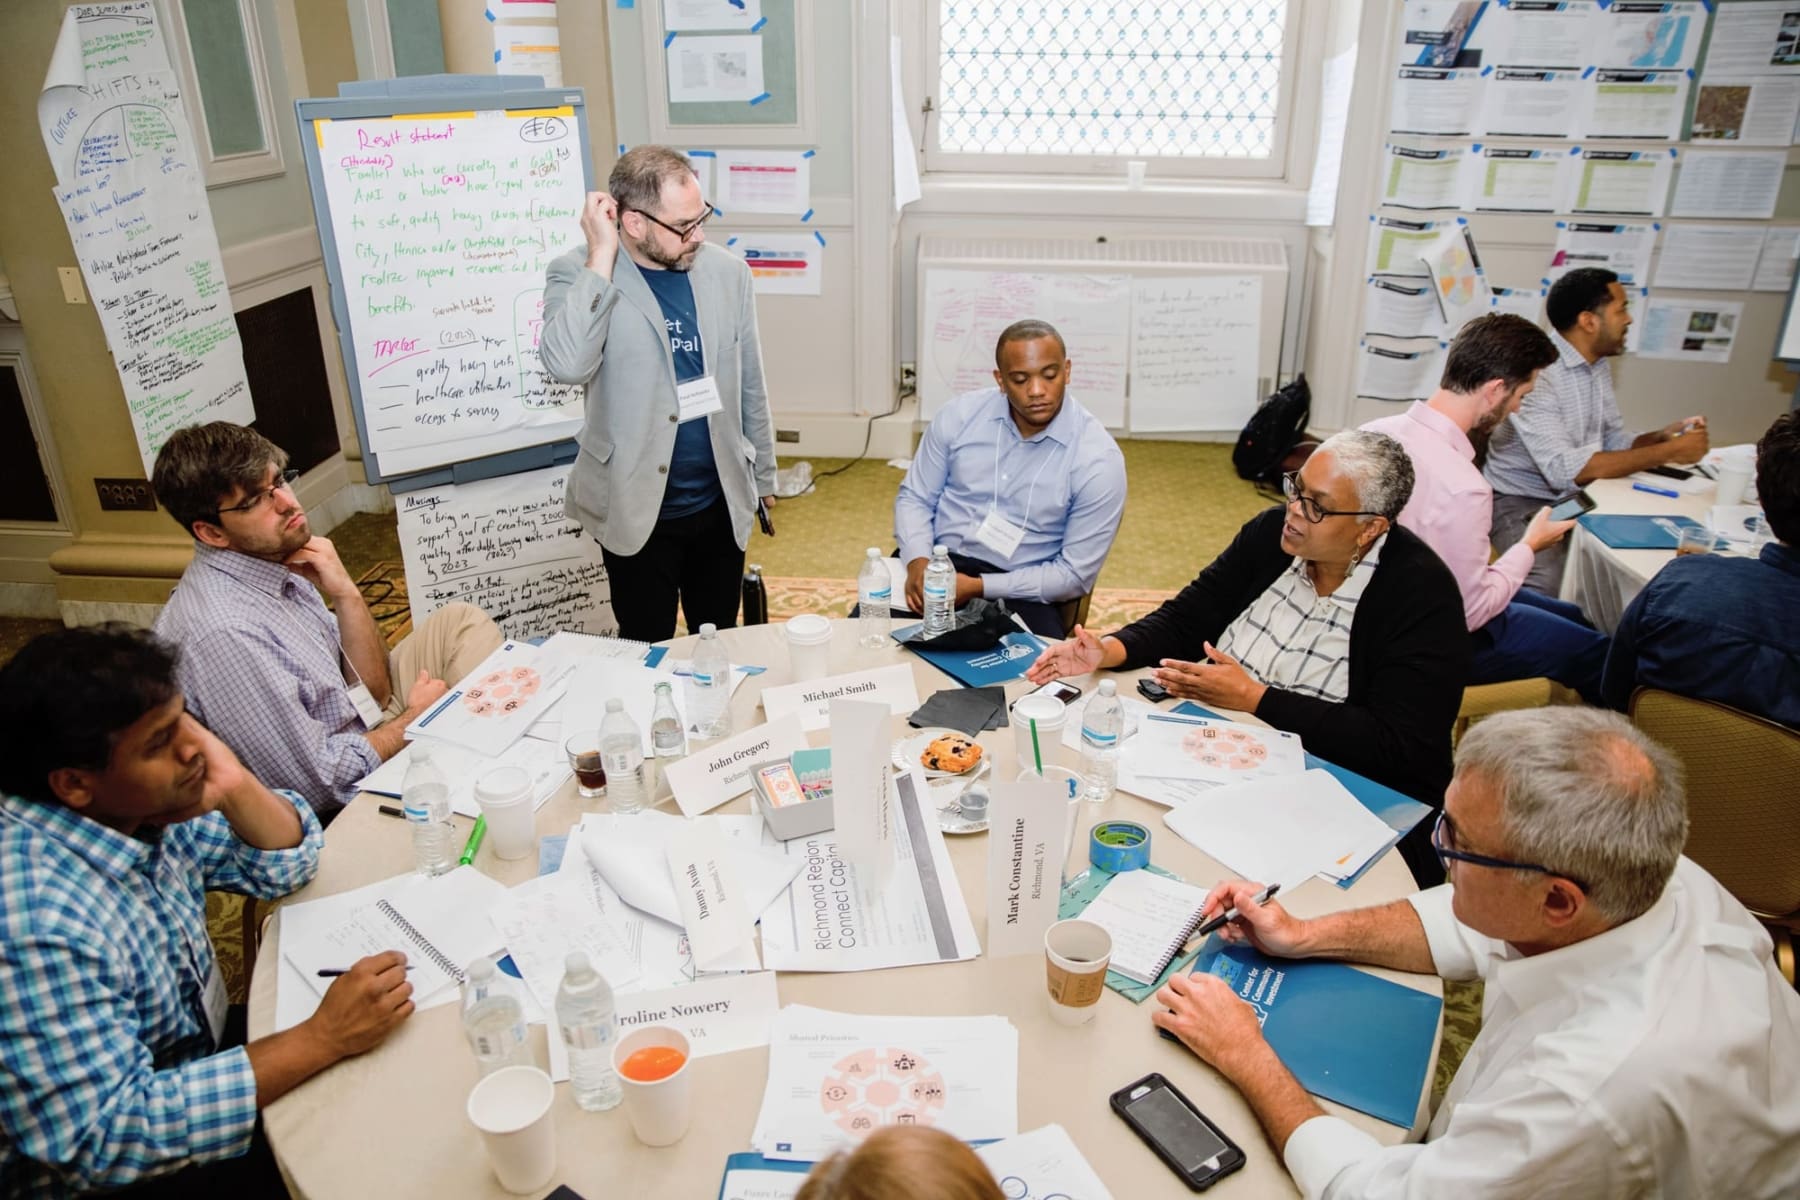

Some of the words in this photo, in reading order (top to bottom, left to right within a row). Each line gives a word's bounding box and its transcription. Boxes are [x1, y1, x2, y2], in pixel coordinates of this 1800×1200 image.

[77, 75, 142, 101] SHIFTS
[358, 128, 401, 150] Result
[405, 496, 440, 511] Musings
[420, 513, 432, 525] To
[435, 512, 457, 529] bring
[461, 512, 470, 520] in
[496, 505, 520, 517] major
[417, 527, 451, 548] support
[482, 519, 496, 535] of
[497, 515, 537, 533] creating
[420, 546, 451, 565] quality
[457, 538, 496, 556] affordable
[427, 564, 438, 582] by
[441, 560, 469, 575] 2023
[459, 582, 471, 592] To
[803, 688, 844, 703] Michael
[845, 681, 877, 696] Smith
[708, 757, 733, 773] John
[733, 739, 770, 761] Gregory
[804, 840, 825, 882] Region
[1008, 818, 1025, 891] Constantine
[1034, 842, 1045, 856] VA
[686, 864, 700, 889] Avula
[1032, 857, 1044, 900] Richmond,
[696, 889, 710, 920] Danny
[808, 884, 833, 950] Richmond
[836, 885, 857, 949] Connect
[1007, 893, 1020, 925] Mark
[1240, 976, 1255, 998] Center
[1248, 967, 1259, 977] for
[1251, 967, 1275, 1001] Community
[1264, 971, 1285, 1006] Investment
[620, 1010, 667, 1027] roline
[671, 1000, 731, 1018] Nowery
[690, 1028, 706, 1038] VA
